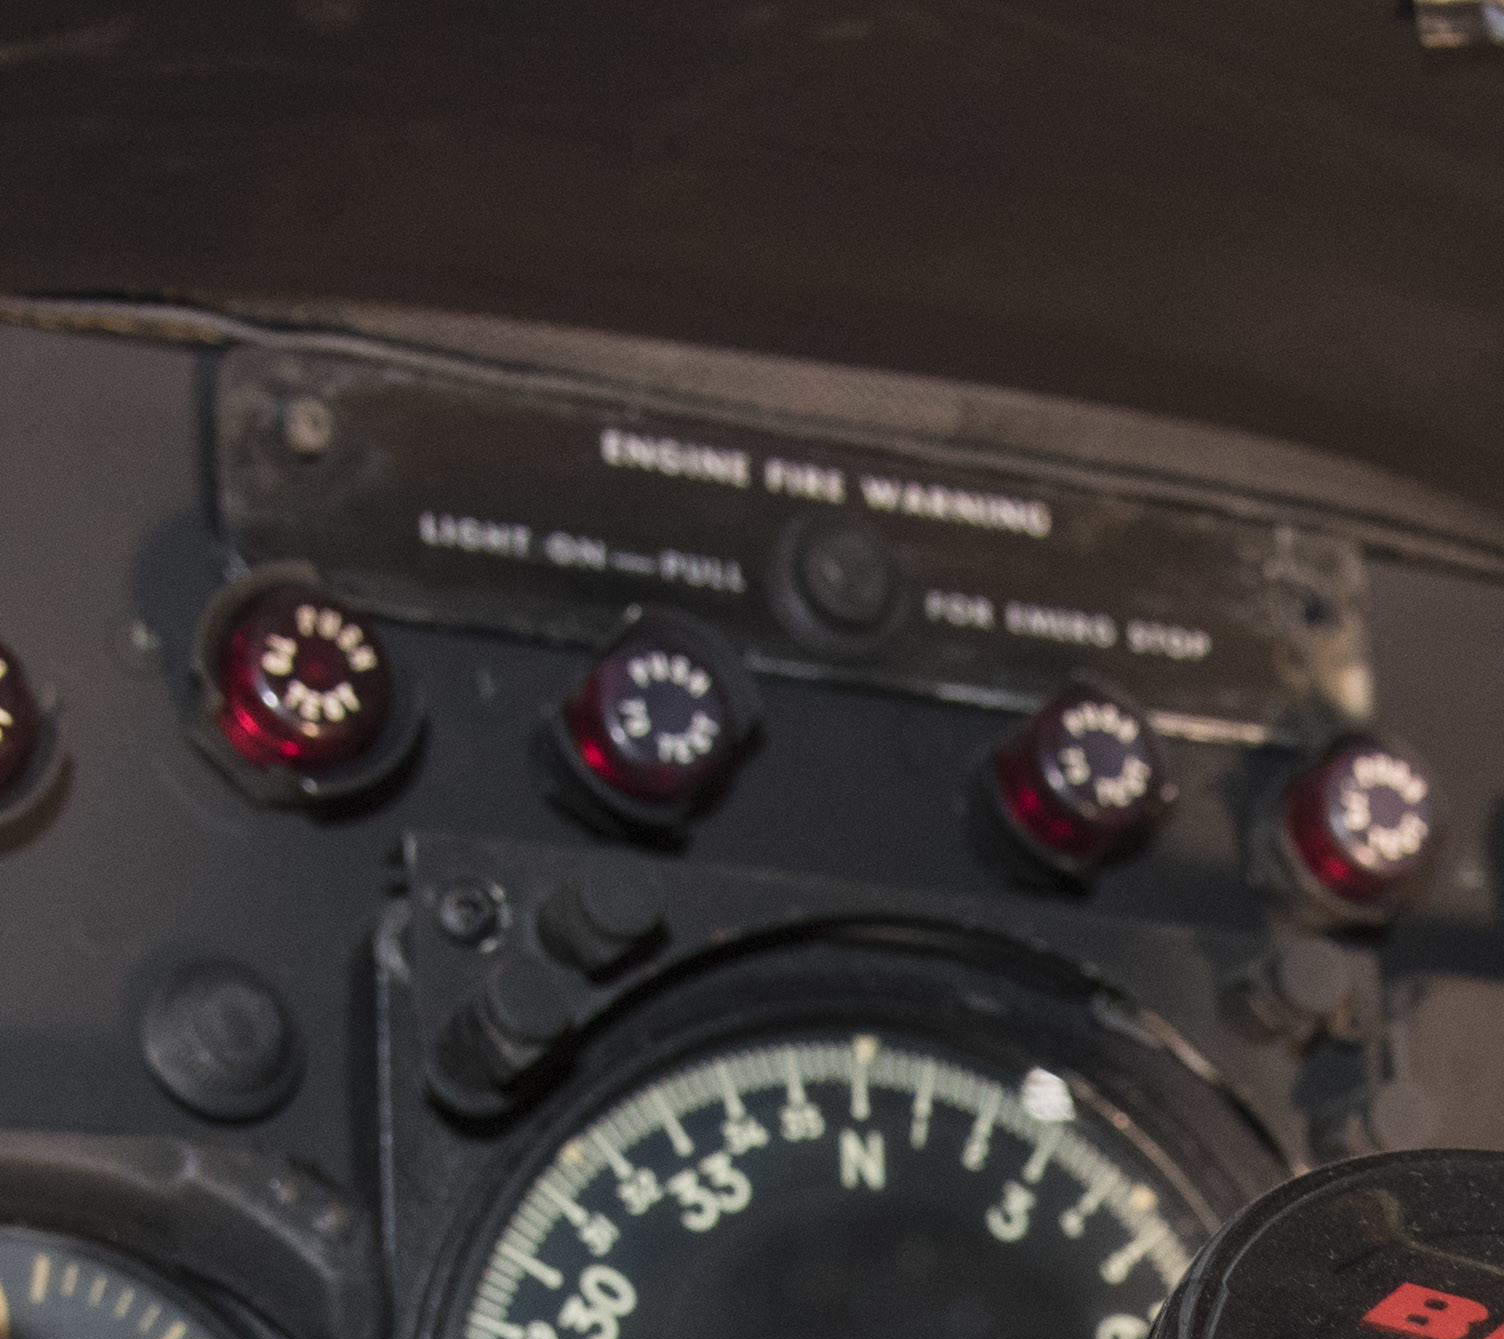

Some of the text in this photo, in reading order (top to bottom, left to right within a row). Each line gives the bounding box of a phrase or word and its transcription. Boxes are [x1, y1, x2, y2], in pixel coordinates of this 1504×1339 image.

[600, 428, 1053, 540] ENGINE FIRE WARNING
[418, 511, 531, 559] LIGHT
[924, 589, 996, 632] FOR
[1126, 619, 1213, 661] STOP
[667, 1150, 752, 1233] 33
[839, 1128, 886, 1192] N
